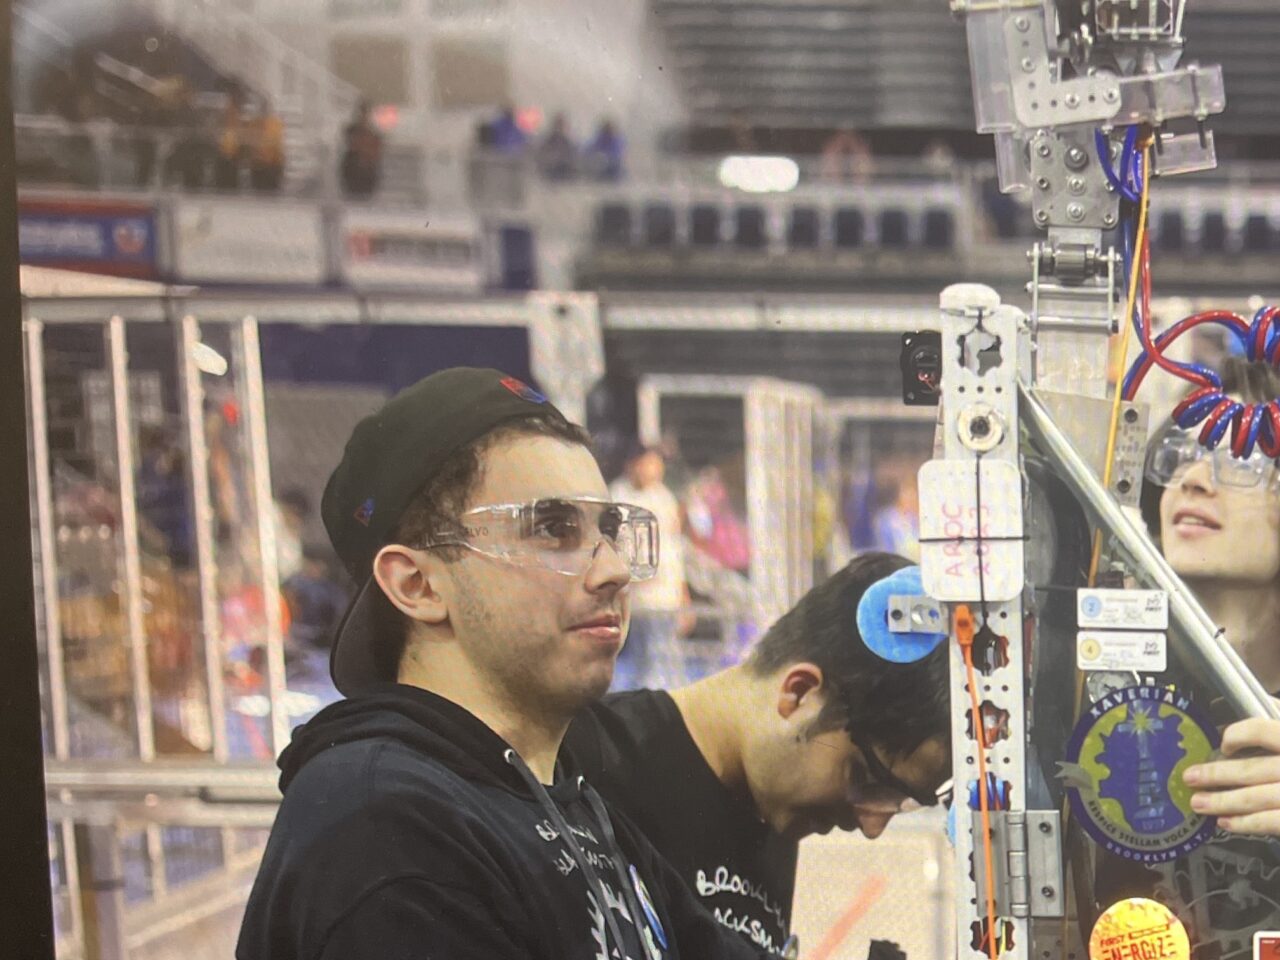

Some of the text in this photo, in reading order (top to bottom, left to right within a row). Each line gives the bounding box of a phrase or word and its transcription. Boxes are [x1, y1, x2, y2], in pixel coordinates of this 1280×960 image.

[1090, 688, 1189, 718] XAVERIAN
[1119, 832, 1160, 846] STELLAM
[1164, 826, 1190, 844] VOCA
[1106, 841, 1177, 861] BROOKLYN
